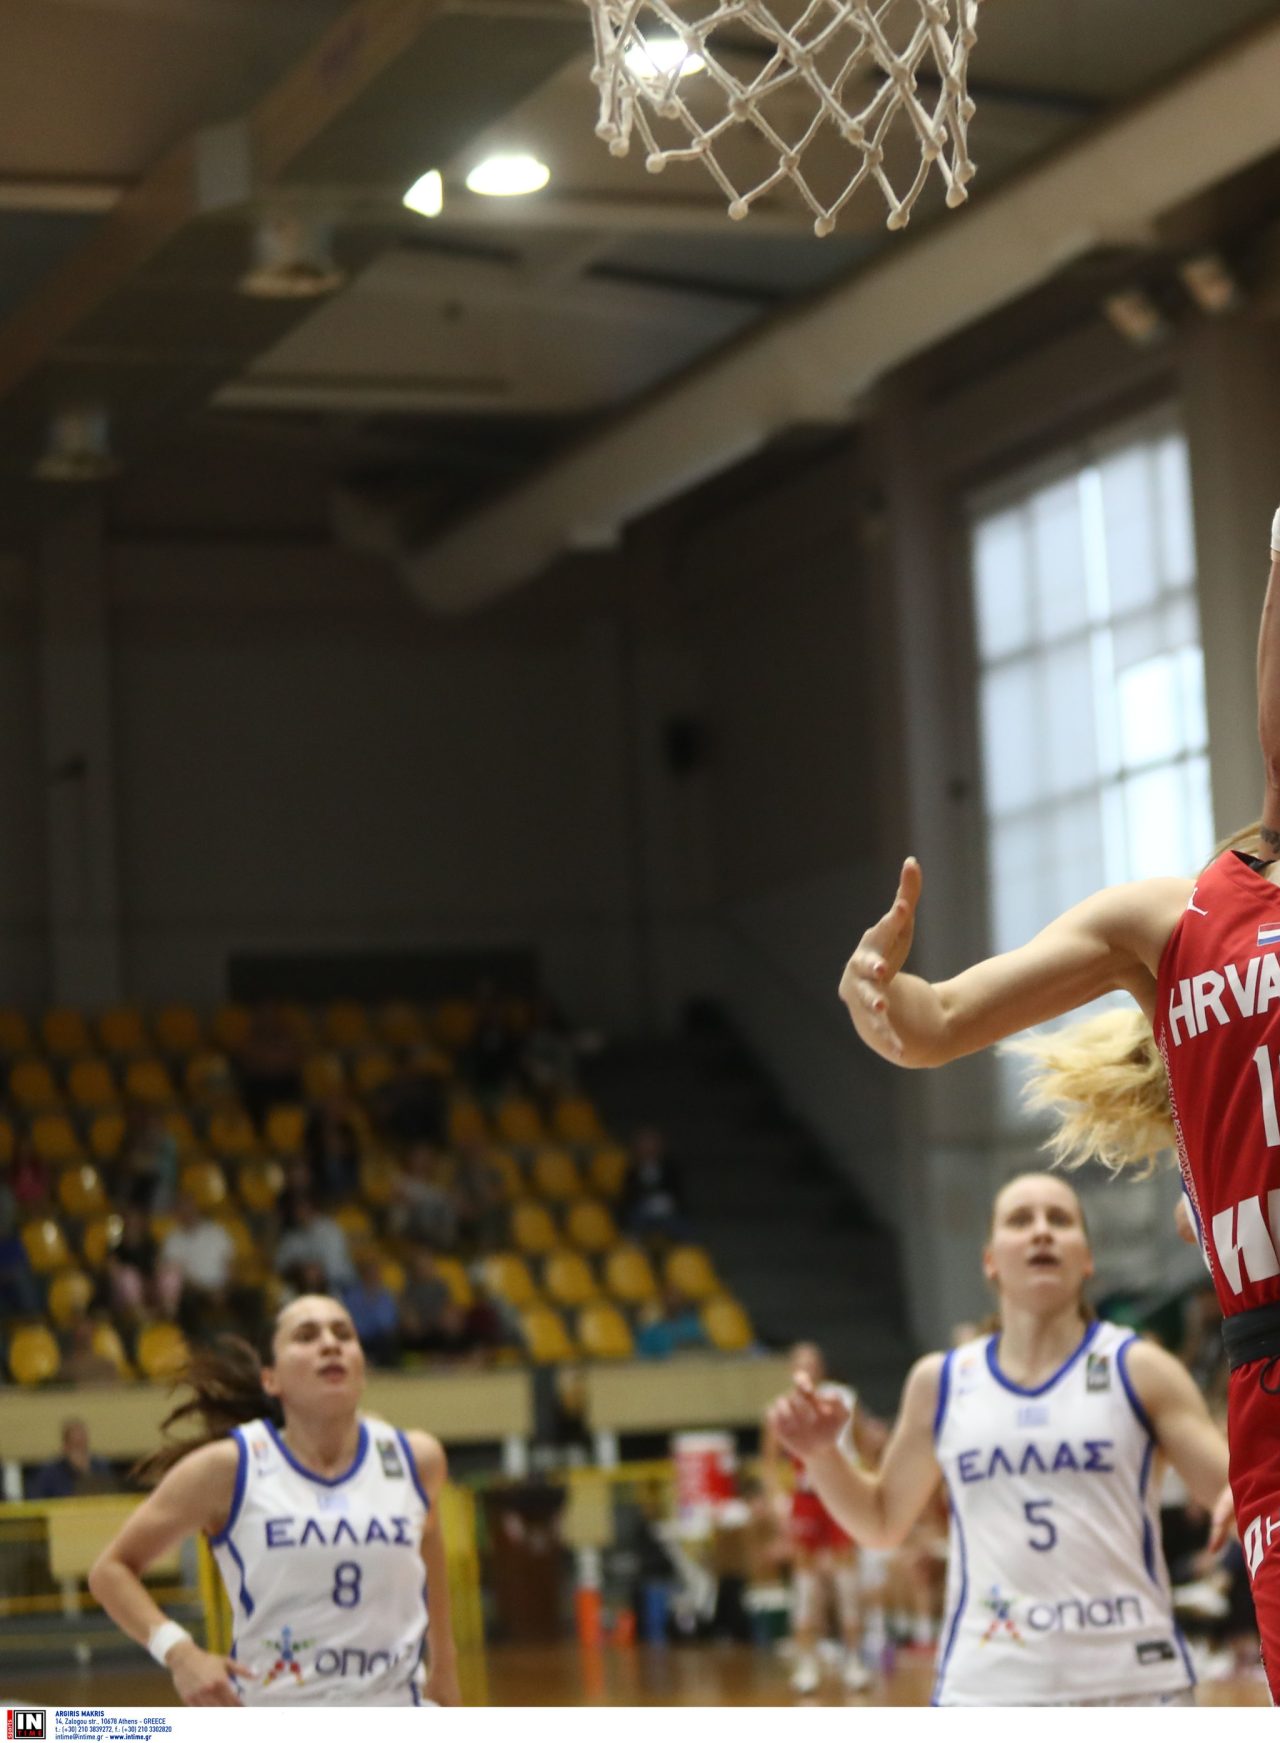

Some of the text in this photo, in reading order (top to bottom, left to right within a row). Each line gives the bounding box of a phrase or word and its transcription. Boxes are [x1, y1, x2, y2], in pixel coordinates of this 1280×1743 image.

[957, 1440, 1114, 1486] ΕΛΛΑΣ
[265, 1516, 413, 1549] ΕΛΛΑΣ
[1023, 1499, 1058, 1553] 5
[331, 1560, 362, 1609] 8
